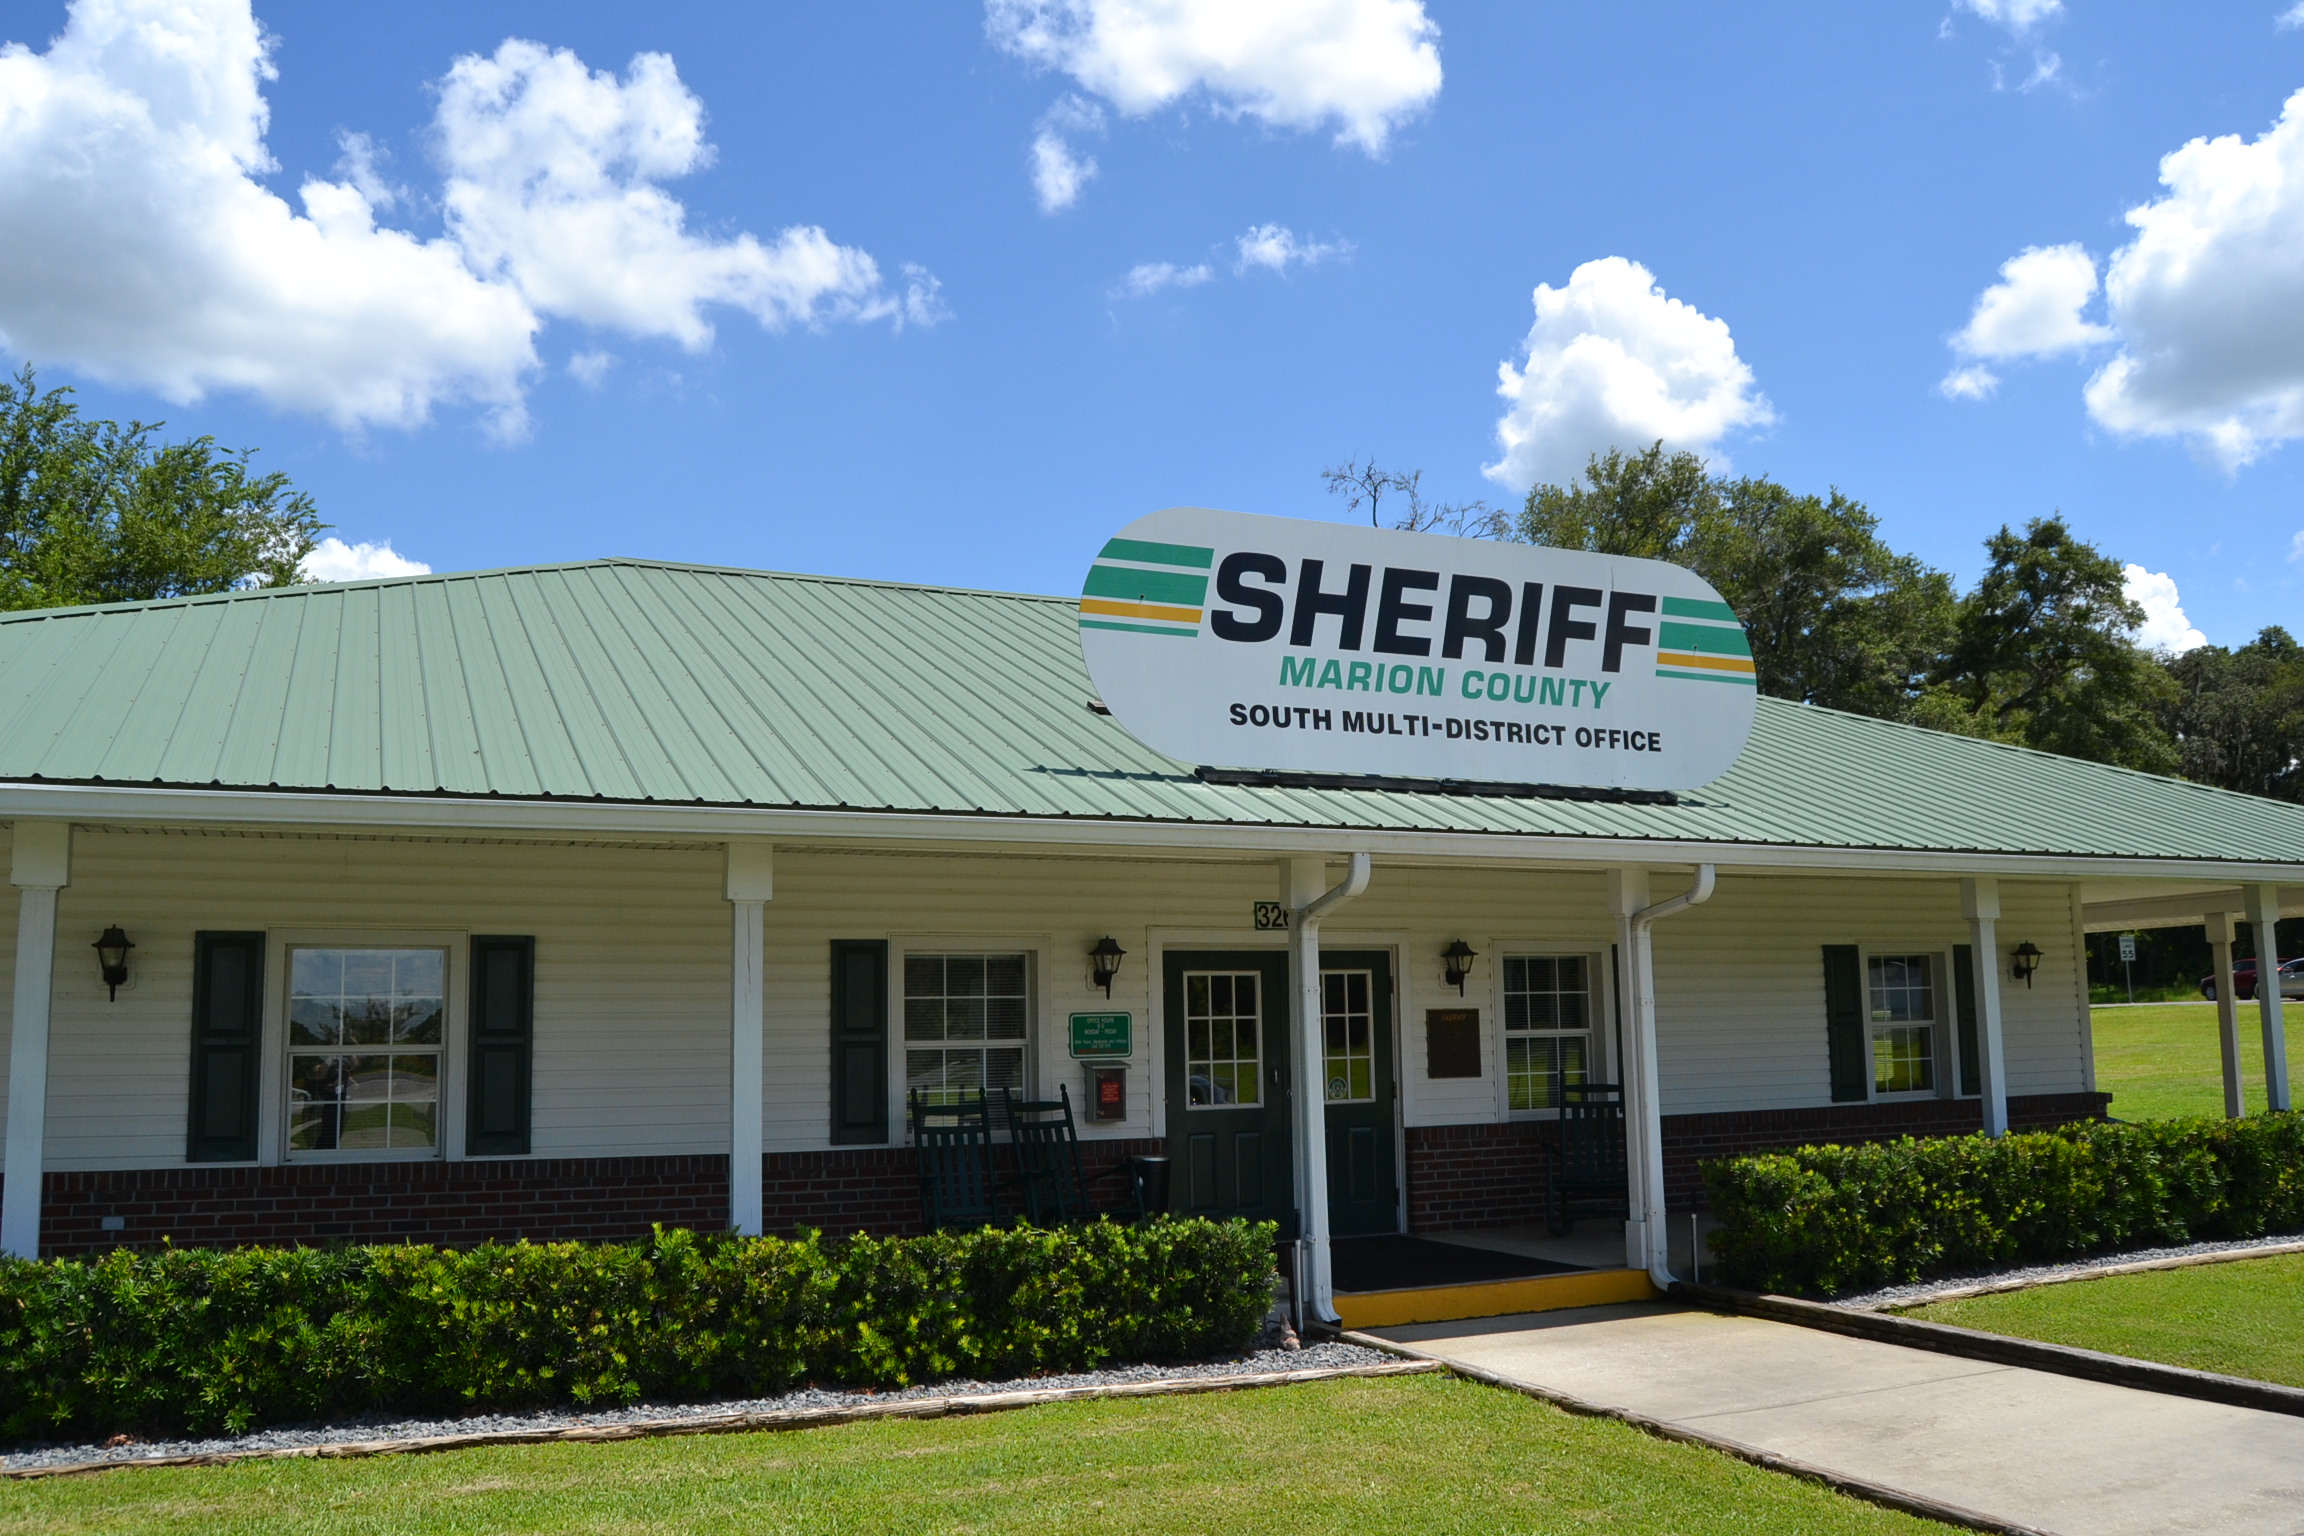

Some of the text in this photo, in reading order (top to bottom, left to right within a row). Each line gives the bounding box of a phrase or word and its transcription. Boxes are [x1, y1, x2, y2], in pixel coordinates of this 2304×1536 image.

[1210, 551, 1657, 673] SHERIFF
[1279, 656, 1611, 709] MARION COUNTY
[1229, 703, 1662, 753] SOUTH MULTI-DISTRICT OFFICE
[2122, 950, 2134, 958] 55
